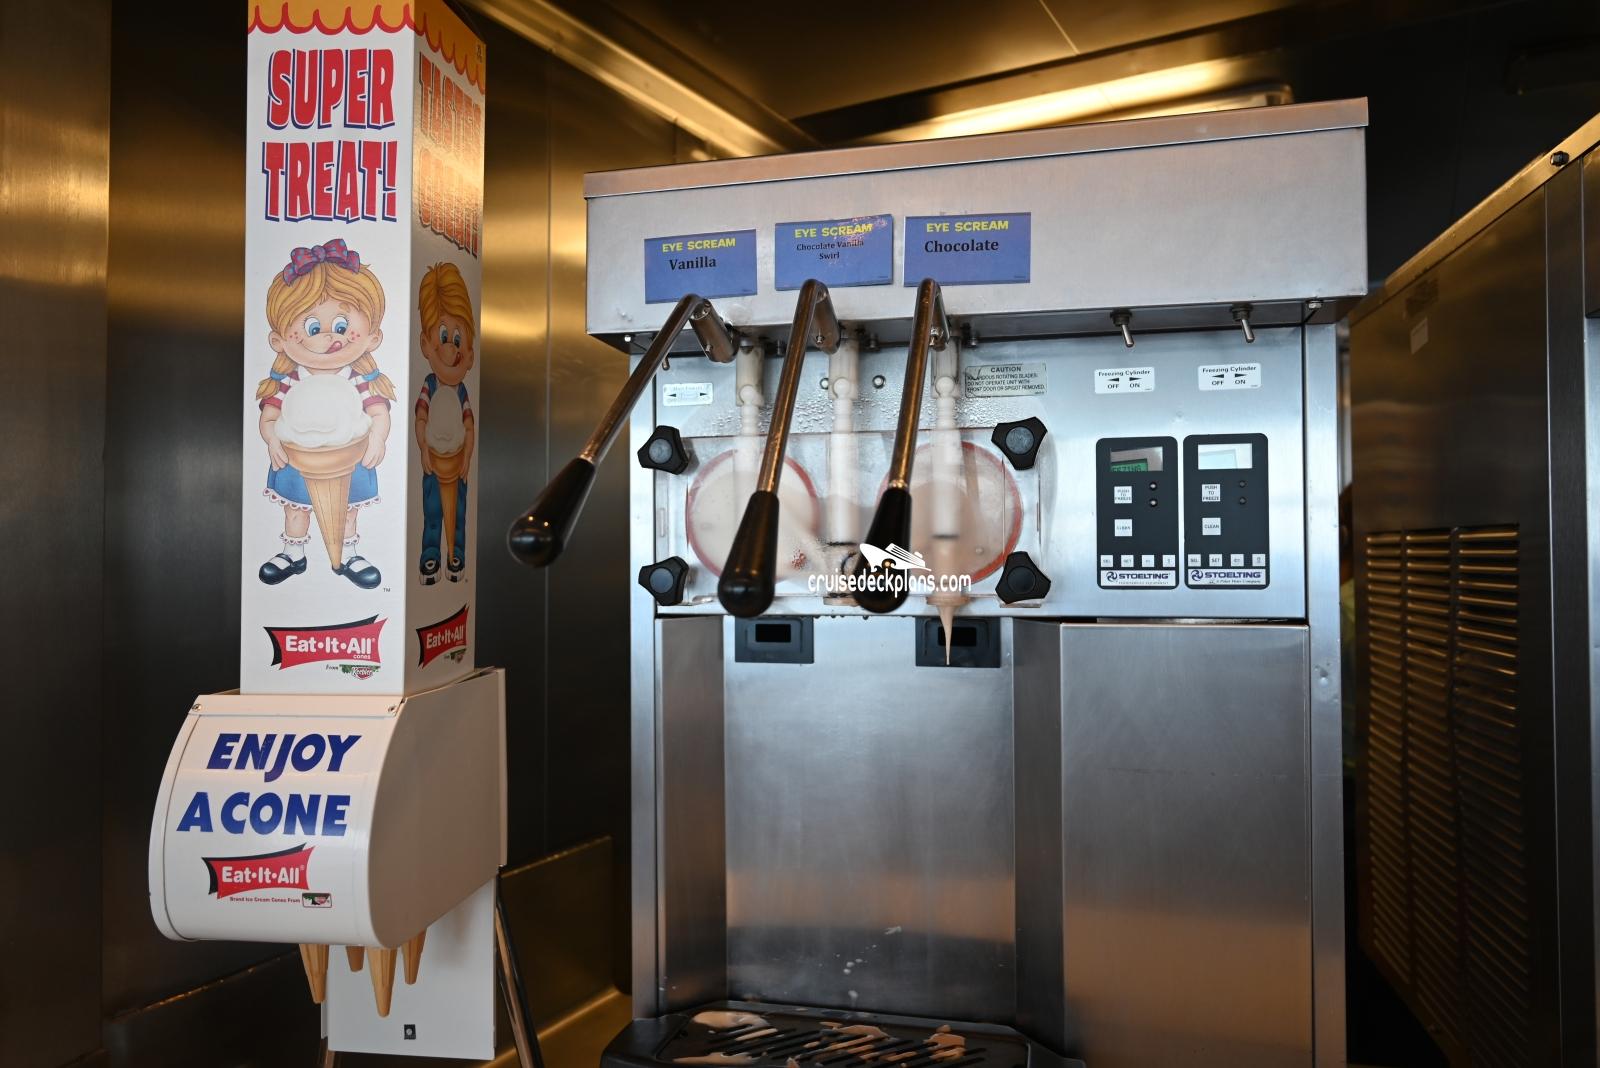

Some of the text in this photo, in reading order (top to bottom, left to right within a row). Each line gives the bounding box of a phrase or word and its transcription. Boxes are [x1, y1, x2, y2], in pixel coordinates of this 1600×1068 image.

[267, 48, 395, 130] SUPER
[262, 140, 398, 224] TREAT!
[794, 223, 873, 238] EYE SCREAM
[926, 220, 1009, 233] EYE SCREAM
[662, 238, 736, 253] EYE SCREAM
[796, 239, 864, 251] Chocolate Vanilla
[924, 239, 999, 253] Chocolate
[819, 252, 840, 260] Swirl
[669, 257, 717, 271] Vanilla
[1204, 571, 1262, 579] STOELTING
[206, 733, 362, 783] ENJOY
[176, 792, 351, 836] A CONE
